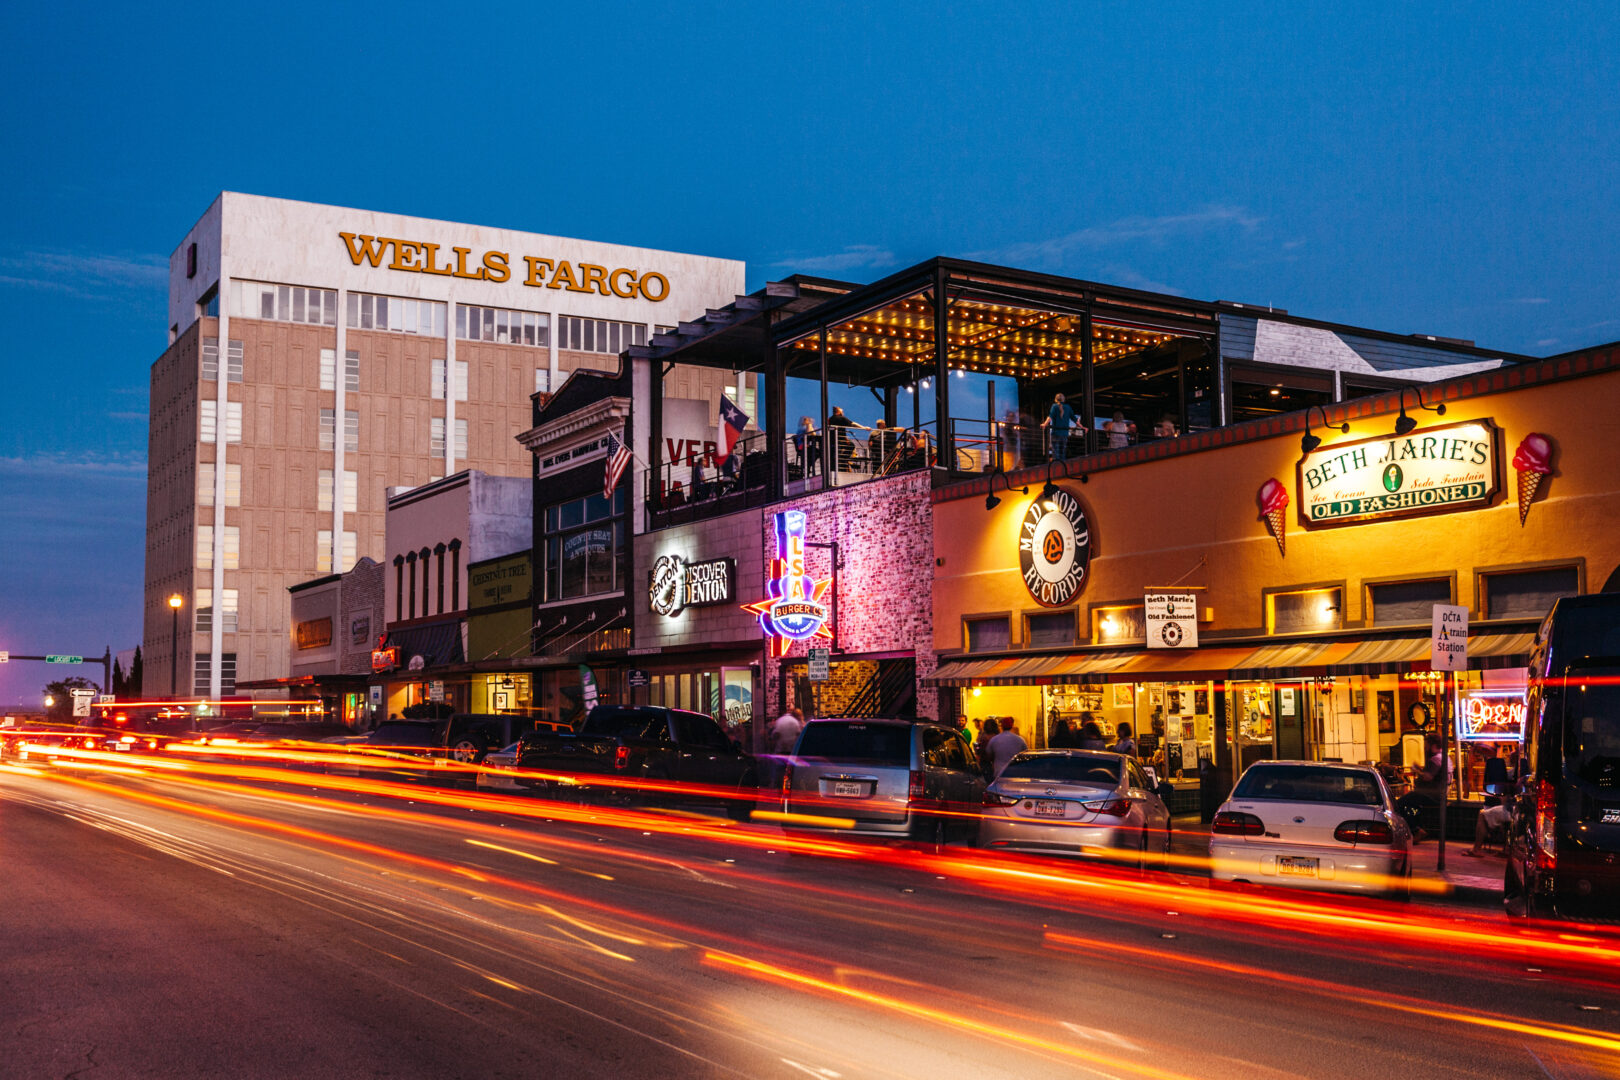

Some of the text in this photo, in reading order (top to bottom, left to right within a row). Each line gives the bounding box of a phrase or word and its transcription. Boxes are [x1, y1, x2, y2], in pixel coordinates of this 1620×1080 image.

[339, 231, 670, 302] WELLS FARGO
[1305, 437, 1489, 490] BETH MARIE'S
[1310, 471, 1485, 503] Ice Cream Soda Fountain
[1314, 484, 1482, 518] OLD FASHIONED
[1021, 490, 1089, 552] MAD WORLD
[649, 559, 681, 602] DENTON
[684, 561, 727, 584] DISCOVER
[792, 537, 804, 599] LSA
[1024, 561, 1084, 604] RECORDS
[683, 579, 728, 604] DENTON
[776, 604, 810, 617] BURGER
[1442, 611, 1461, 622] DCTA
[810, 650, 815, 660] 2
[1437, 642, 1464, 652] Station
[1467, 698, 1522, 725] OPEN
